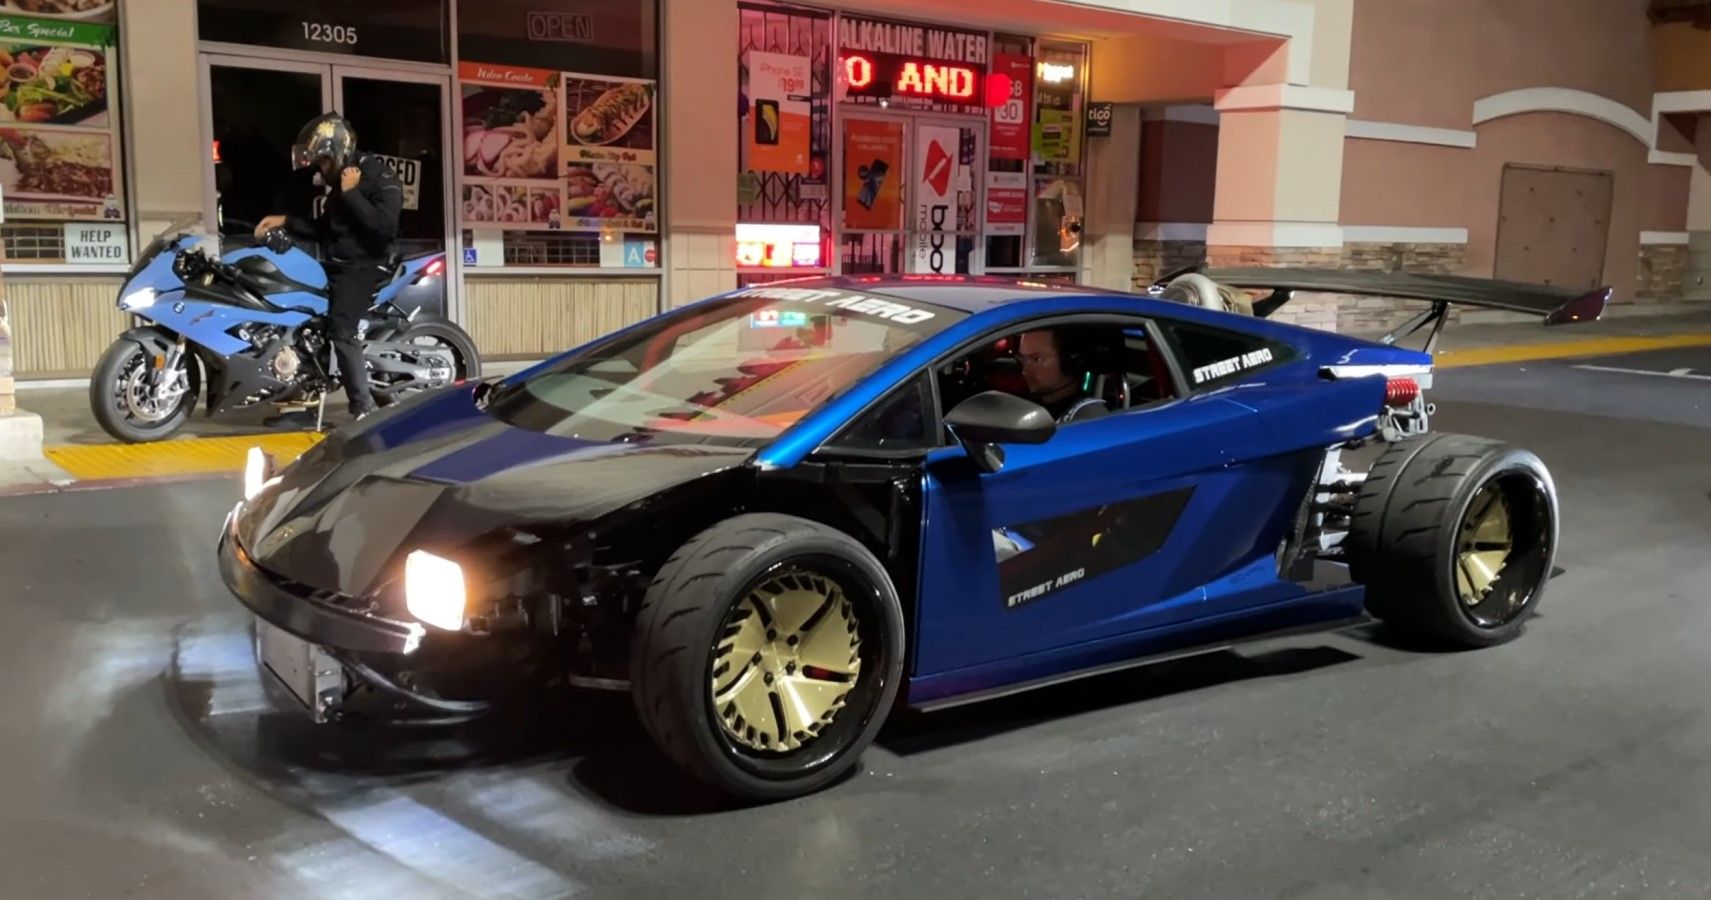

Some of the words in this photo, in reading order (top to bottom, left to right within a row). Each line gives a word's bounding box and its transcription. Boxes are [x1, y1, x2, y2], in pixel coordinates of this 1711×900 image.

[27, 23, 75, 38] Special
[302, 21, 357, 44] 12305
[531, 14, 590, 39] OPEN
[839, 18, 923, 57] ALKALINE
[928, 28, 987, 64] WATER
[897, 62, 973, 97] AND
[999, 101, 1018, 121] 30
[376, 156, 416, 186] SED
[80, 229, 112, 243] HELP
[918, 203, 928, 260] mobile
[71, 245, 122, 259] WANTED
[628, 247, 641, 263] A
[824, 295, 936, 324] AERO
[1193, 355, 1241, 384] STREET
[1241, 347, 1273, 369] AERO
[1008, 579, 1053, 607] STREET
[1055, 567, 1085, 588] AERO
